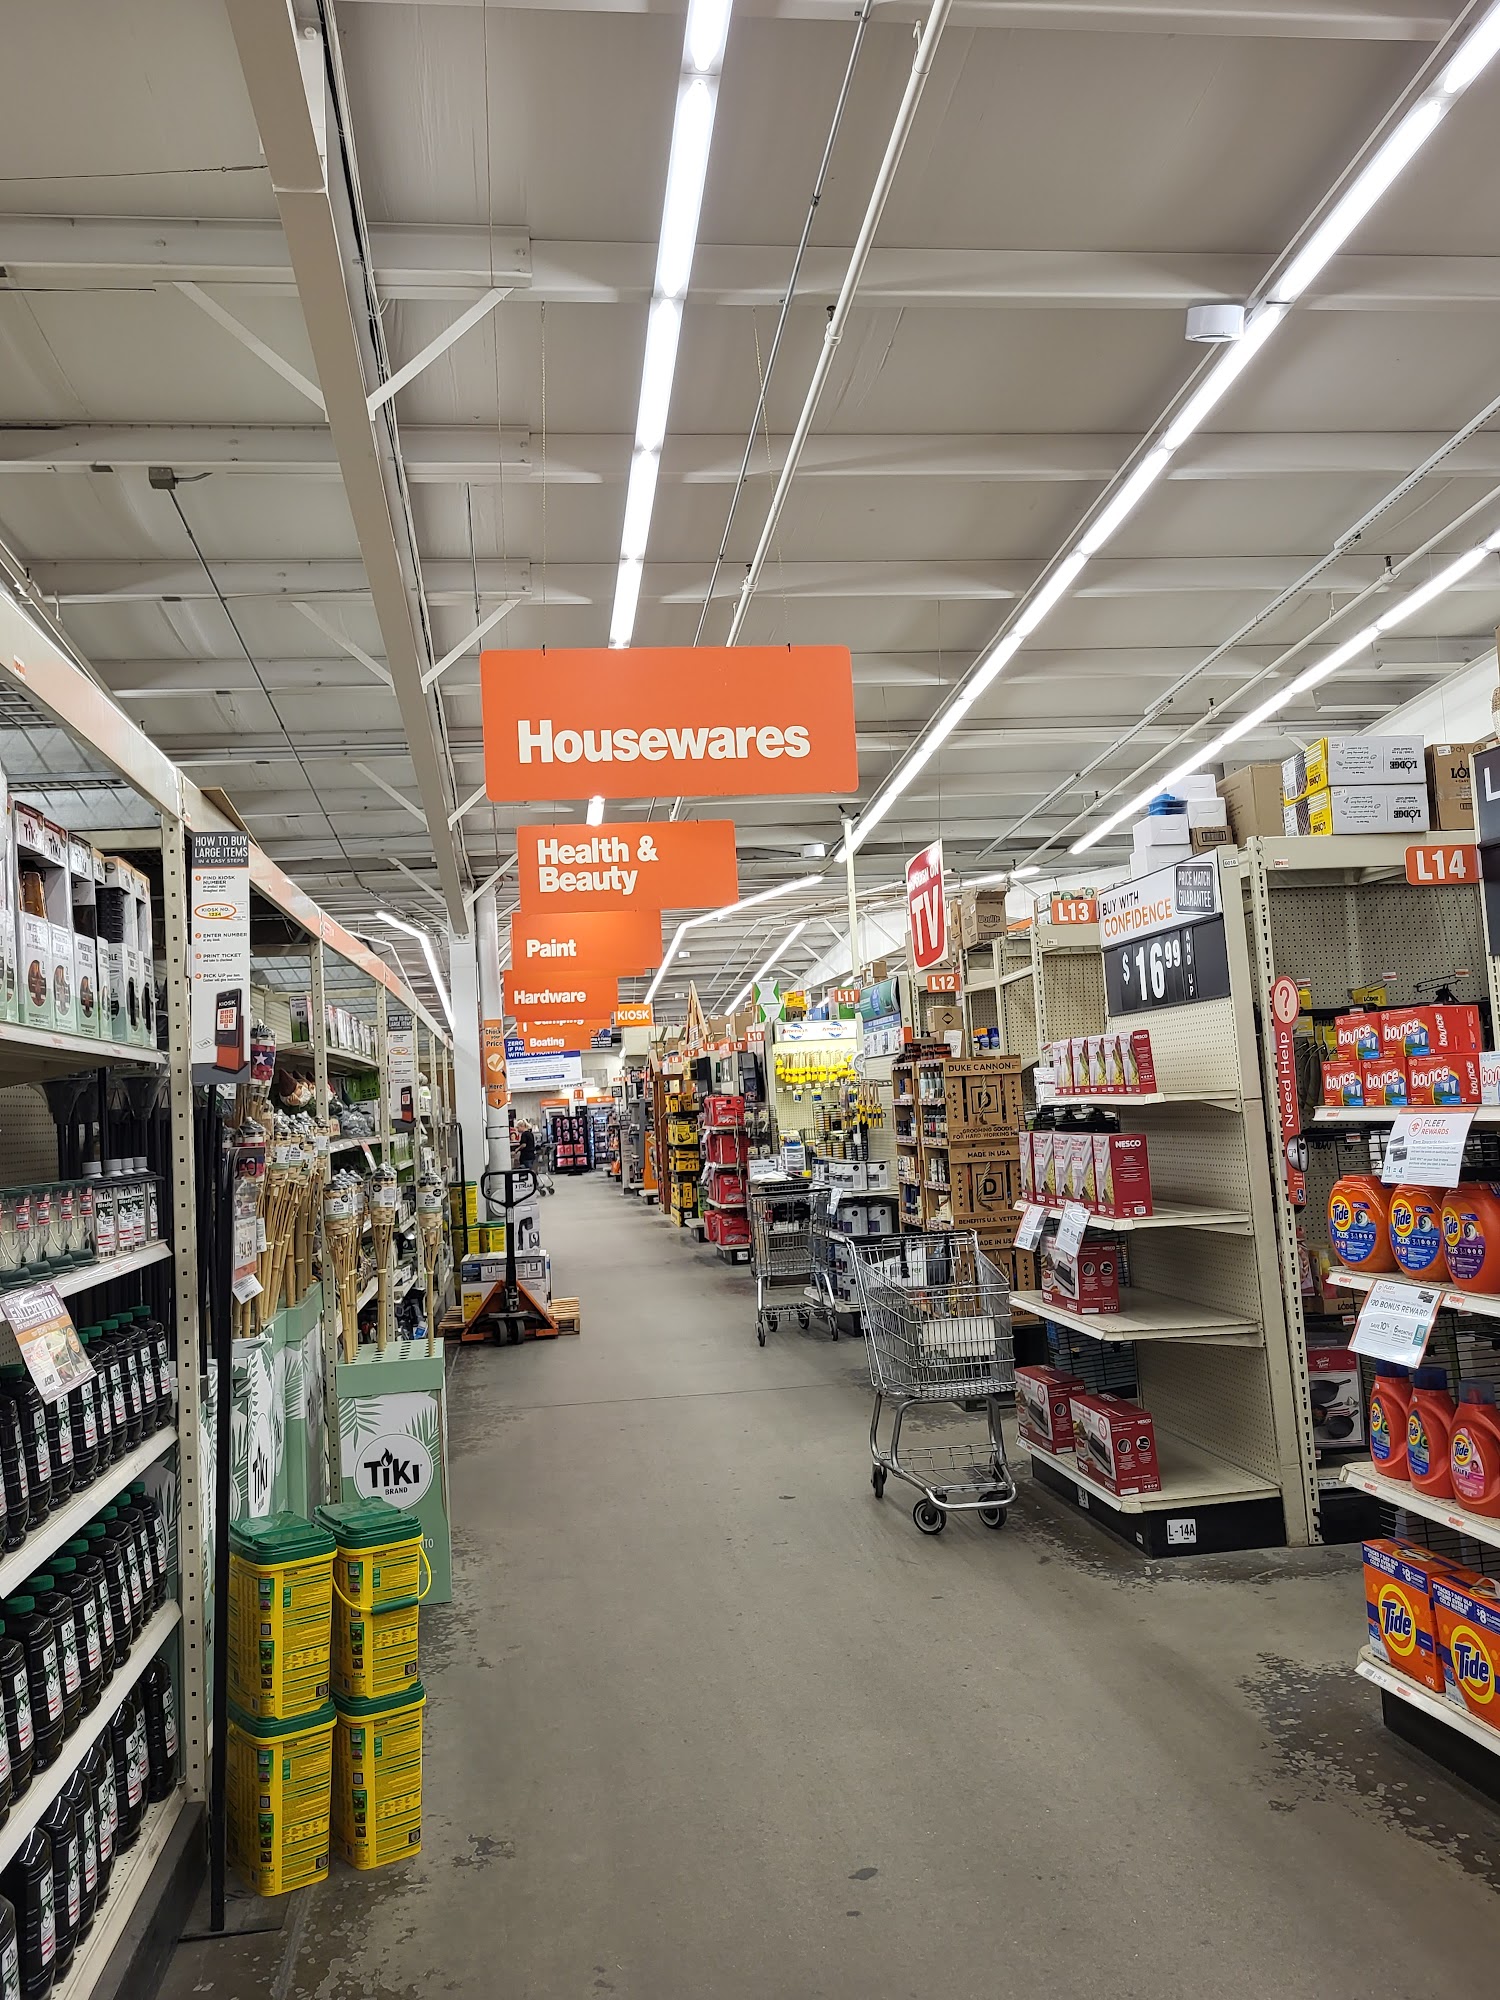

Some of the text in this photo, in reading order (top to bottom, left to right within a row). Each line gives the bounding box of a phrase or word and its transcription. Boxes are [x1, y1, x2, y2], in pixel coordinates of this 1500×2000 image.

[517, 719, 810, 764] Housewares
[1390, 760, 1418, 774] LODGE
[1394, 810, 1421, 824] LODGE
[196, 836, 247, 846] HOW TO BUY
[194, 847, 248, 858] LARGE ITEMS
[537, 835, 659, 866] Health &
[1416, 850, 1466, 880] L14
[538, 865, 638, 896] Beauty
[1178, 870, 1210, 886] PRICE MATCH
[1102, 890, 1139, 916] BUY WITH
[1178, 890, 1211, 908] GUARANTEE
[911, 884, 940, 956] TV
[1058, 902, 1089, 922] L13
[1104, 898, 1173, 938] CONFIDENCE
[526, 938, 577, 958] Paint
[931, 976, 954, 990] L12
[514, 990, 586, 1004] Hardware
[838, 991, 855, 1002] L11
[617, 1010, 649, 1020] KIOSK
[748, 1032, 762, 1041] L10
[1338, 1024, 1371, 1046] bounce
[1384, 1019, 1420, 1040] bounce
[1435, 1013, 1448, 1046] bounce
[530, 1037, 564, 1048] Boating
[973, 1062, 1011, 1070] CANNON
[1279, 1031, 1294, 1127] Need Help
[1326, 1072, 1356, 1090] bounce
[1367, 1069, 1399, 1089] bounce
[1412, 1066, 1449, 1087] bounce
[1466, 1061, 1478, 1095] bounce
[984, 1179, 996, 1195] D
[1333, 1204, 1349, 1223] Tide
[1394, 1208, 1411, 1228] Tide
[1444, 1216, 1458, 1234] Tide
[1380, 1300, 1400, 1311] BONUS
[1394, 1325, 1398, 1333] 6
[1409, 1423, 1418, 1437] Tide
[1455, 1442, 1469, 1456] Tide
[364, 1450, 421, 1488] TiKi
[385, 1487, 408, 1495] BRAND
[1370, 1558, 1380, 1567] COLD
[1402, 1567, 1411, 1581] $8
[1433, 1583, 1451, 1595] ATTACKS
[1463, 1598, 1472, 1606] OLD
[1440, 1598, 1450, 1606] COLD
[1452, 1597, 1462, 1606] EVEN
[1382, 1600, 1411, 1636] Tide
[1476, 1608, 1486, 1624] $8
[1454, 1642, 1489, 1682] Tide
[1425, 1675, 1435, 1686] 102
